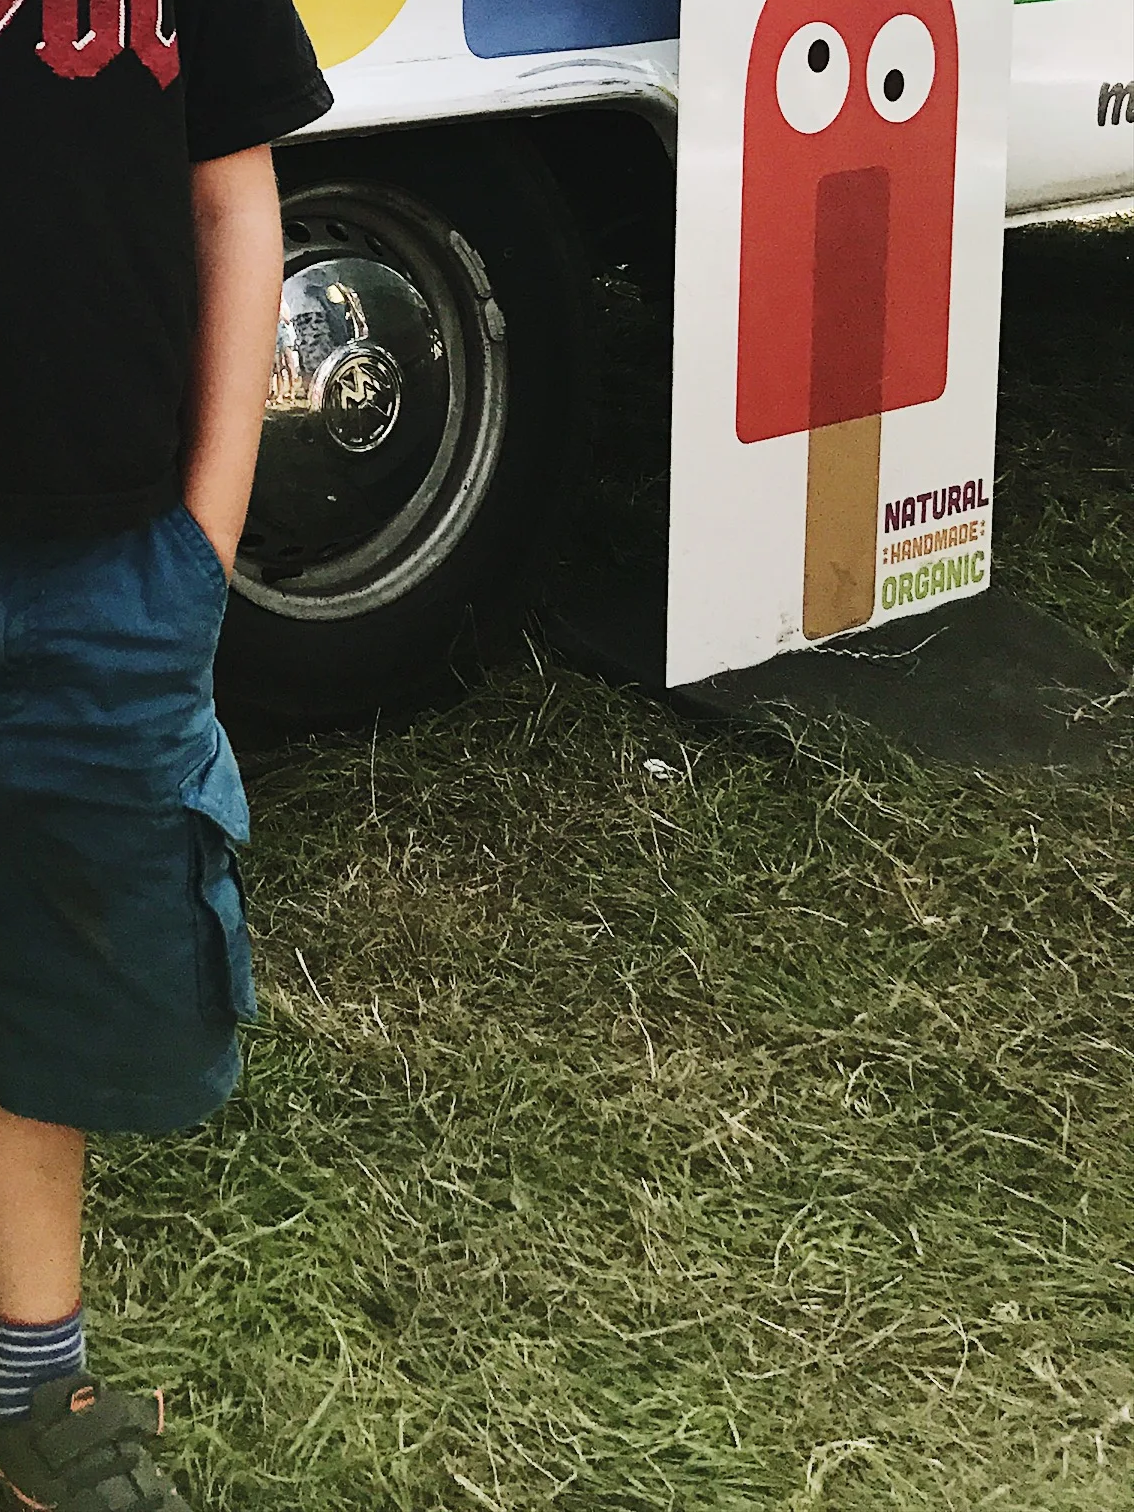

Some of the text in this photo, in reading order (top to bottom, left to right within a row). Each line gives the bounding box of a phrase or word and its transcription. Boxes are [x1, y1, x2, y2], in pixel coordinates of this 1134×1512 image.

[884, 478, 990, 534] NATURAL
[890, 520, 979, 565] HANDMADE
[881, 550, 985, 610] ORGANIC
